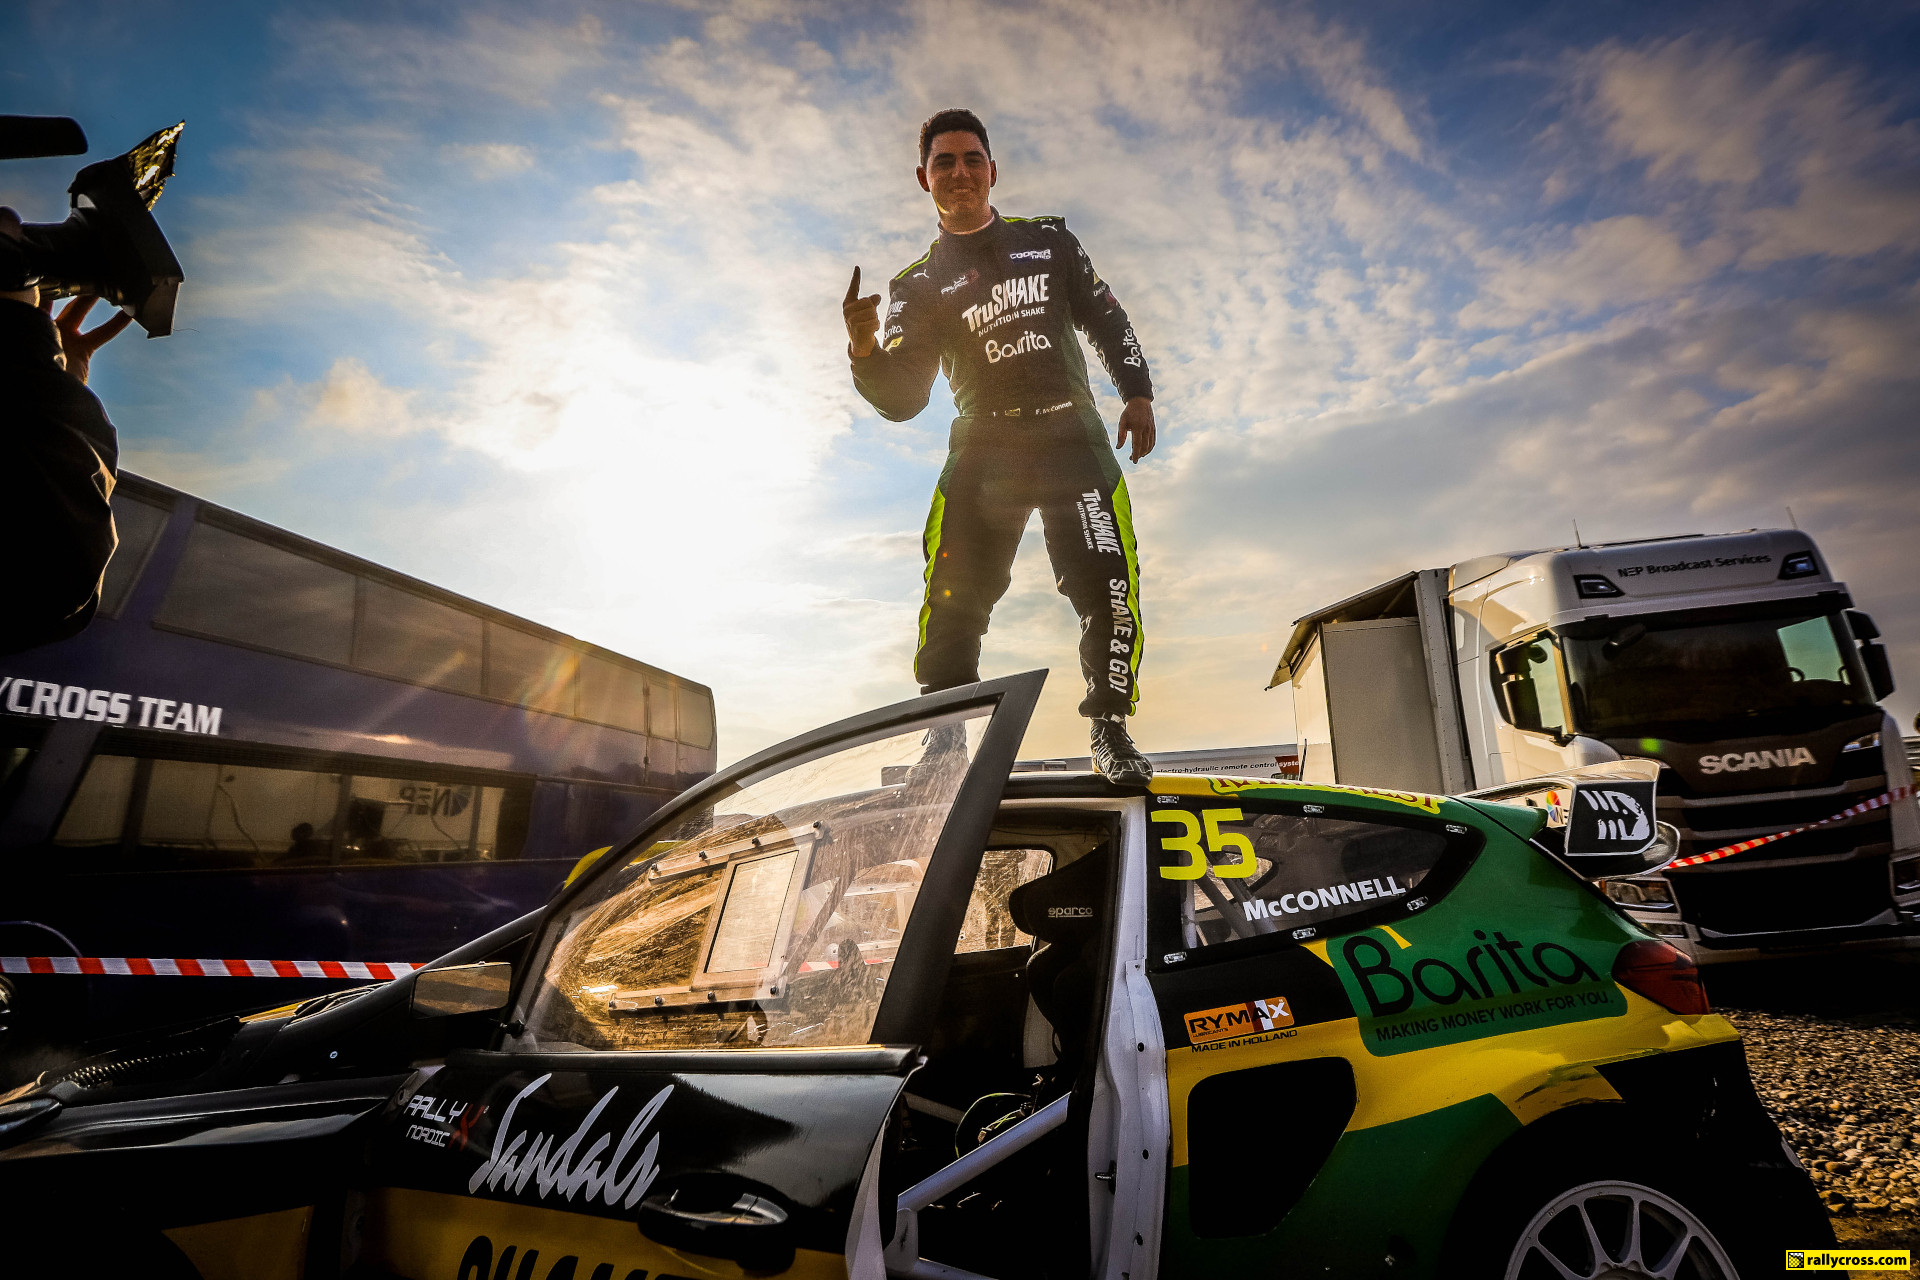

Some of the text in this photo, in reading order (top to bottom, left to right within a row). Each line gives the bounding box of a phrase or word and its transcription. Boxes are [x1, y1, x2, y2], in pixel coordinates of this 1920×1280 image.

[1020, 306, 1045, 317] SHAKE
[985, 330, 1052, 364] Barita
[1083, 529, 1094, 550] SHAKE
[1617, 554, 1771, 578] NEP Broadcast Services
[1108, 578, 1133, 694] SHAKE & GO!
[137, 695, 223, 736] TEAM
[1249, 761, 1277, 769] control
[1699, 746, 1817, 775] SCANIA
[1150, 807, 1257, 880] 35
[1048, 906, 1093, 919] sparco
[1242, 875, 1406, 921] McCONNELL
[1342, 929, 1600, 1018] Barita
[1188, 1000, 1290, 1034] RYMAX
[1375, 990, 1614, 1042] MAKING MONEY WORK FOR YOU.
[1191, 1029, 1298, 1053] MADE IN HOLLAND
[1192, 1027, 1229, 1038] LUBRICANTS
[406, 1124, 450, 1148] NORDIC
[468, 1072, 675, 1210] Sandals
